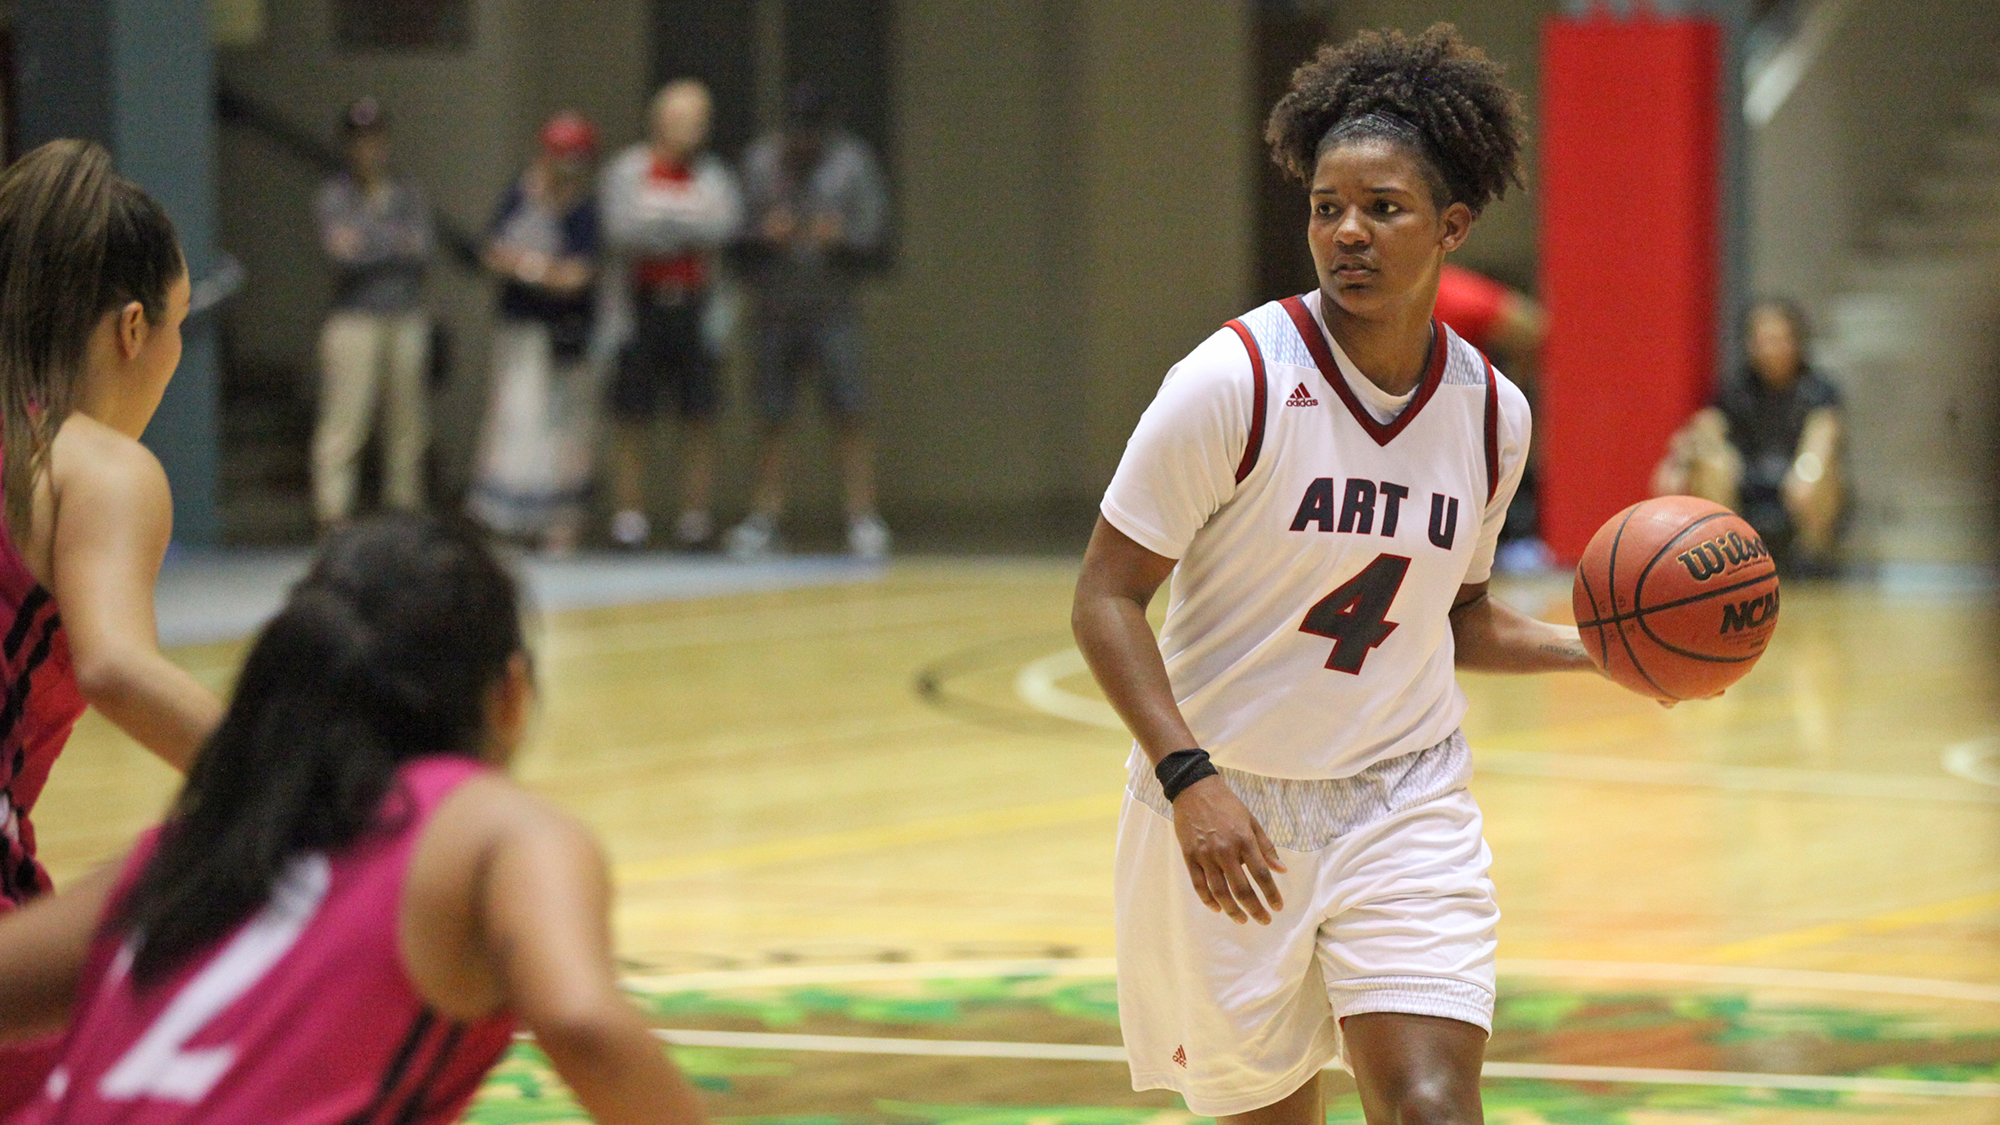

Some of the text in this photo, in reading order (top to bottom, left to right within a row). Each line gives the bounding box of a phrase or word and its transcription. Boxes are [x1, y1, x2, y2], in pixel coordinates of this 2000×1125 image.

[1286, 397, 1319, 408] adidas
[1289, 477, 1459, 551] ART U
[1676, 531, 1769, 583] Wilso
[1298, 552, 1412, 676] 4
